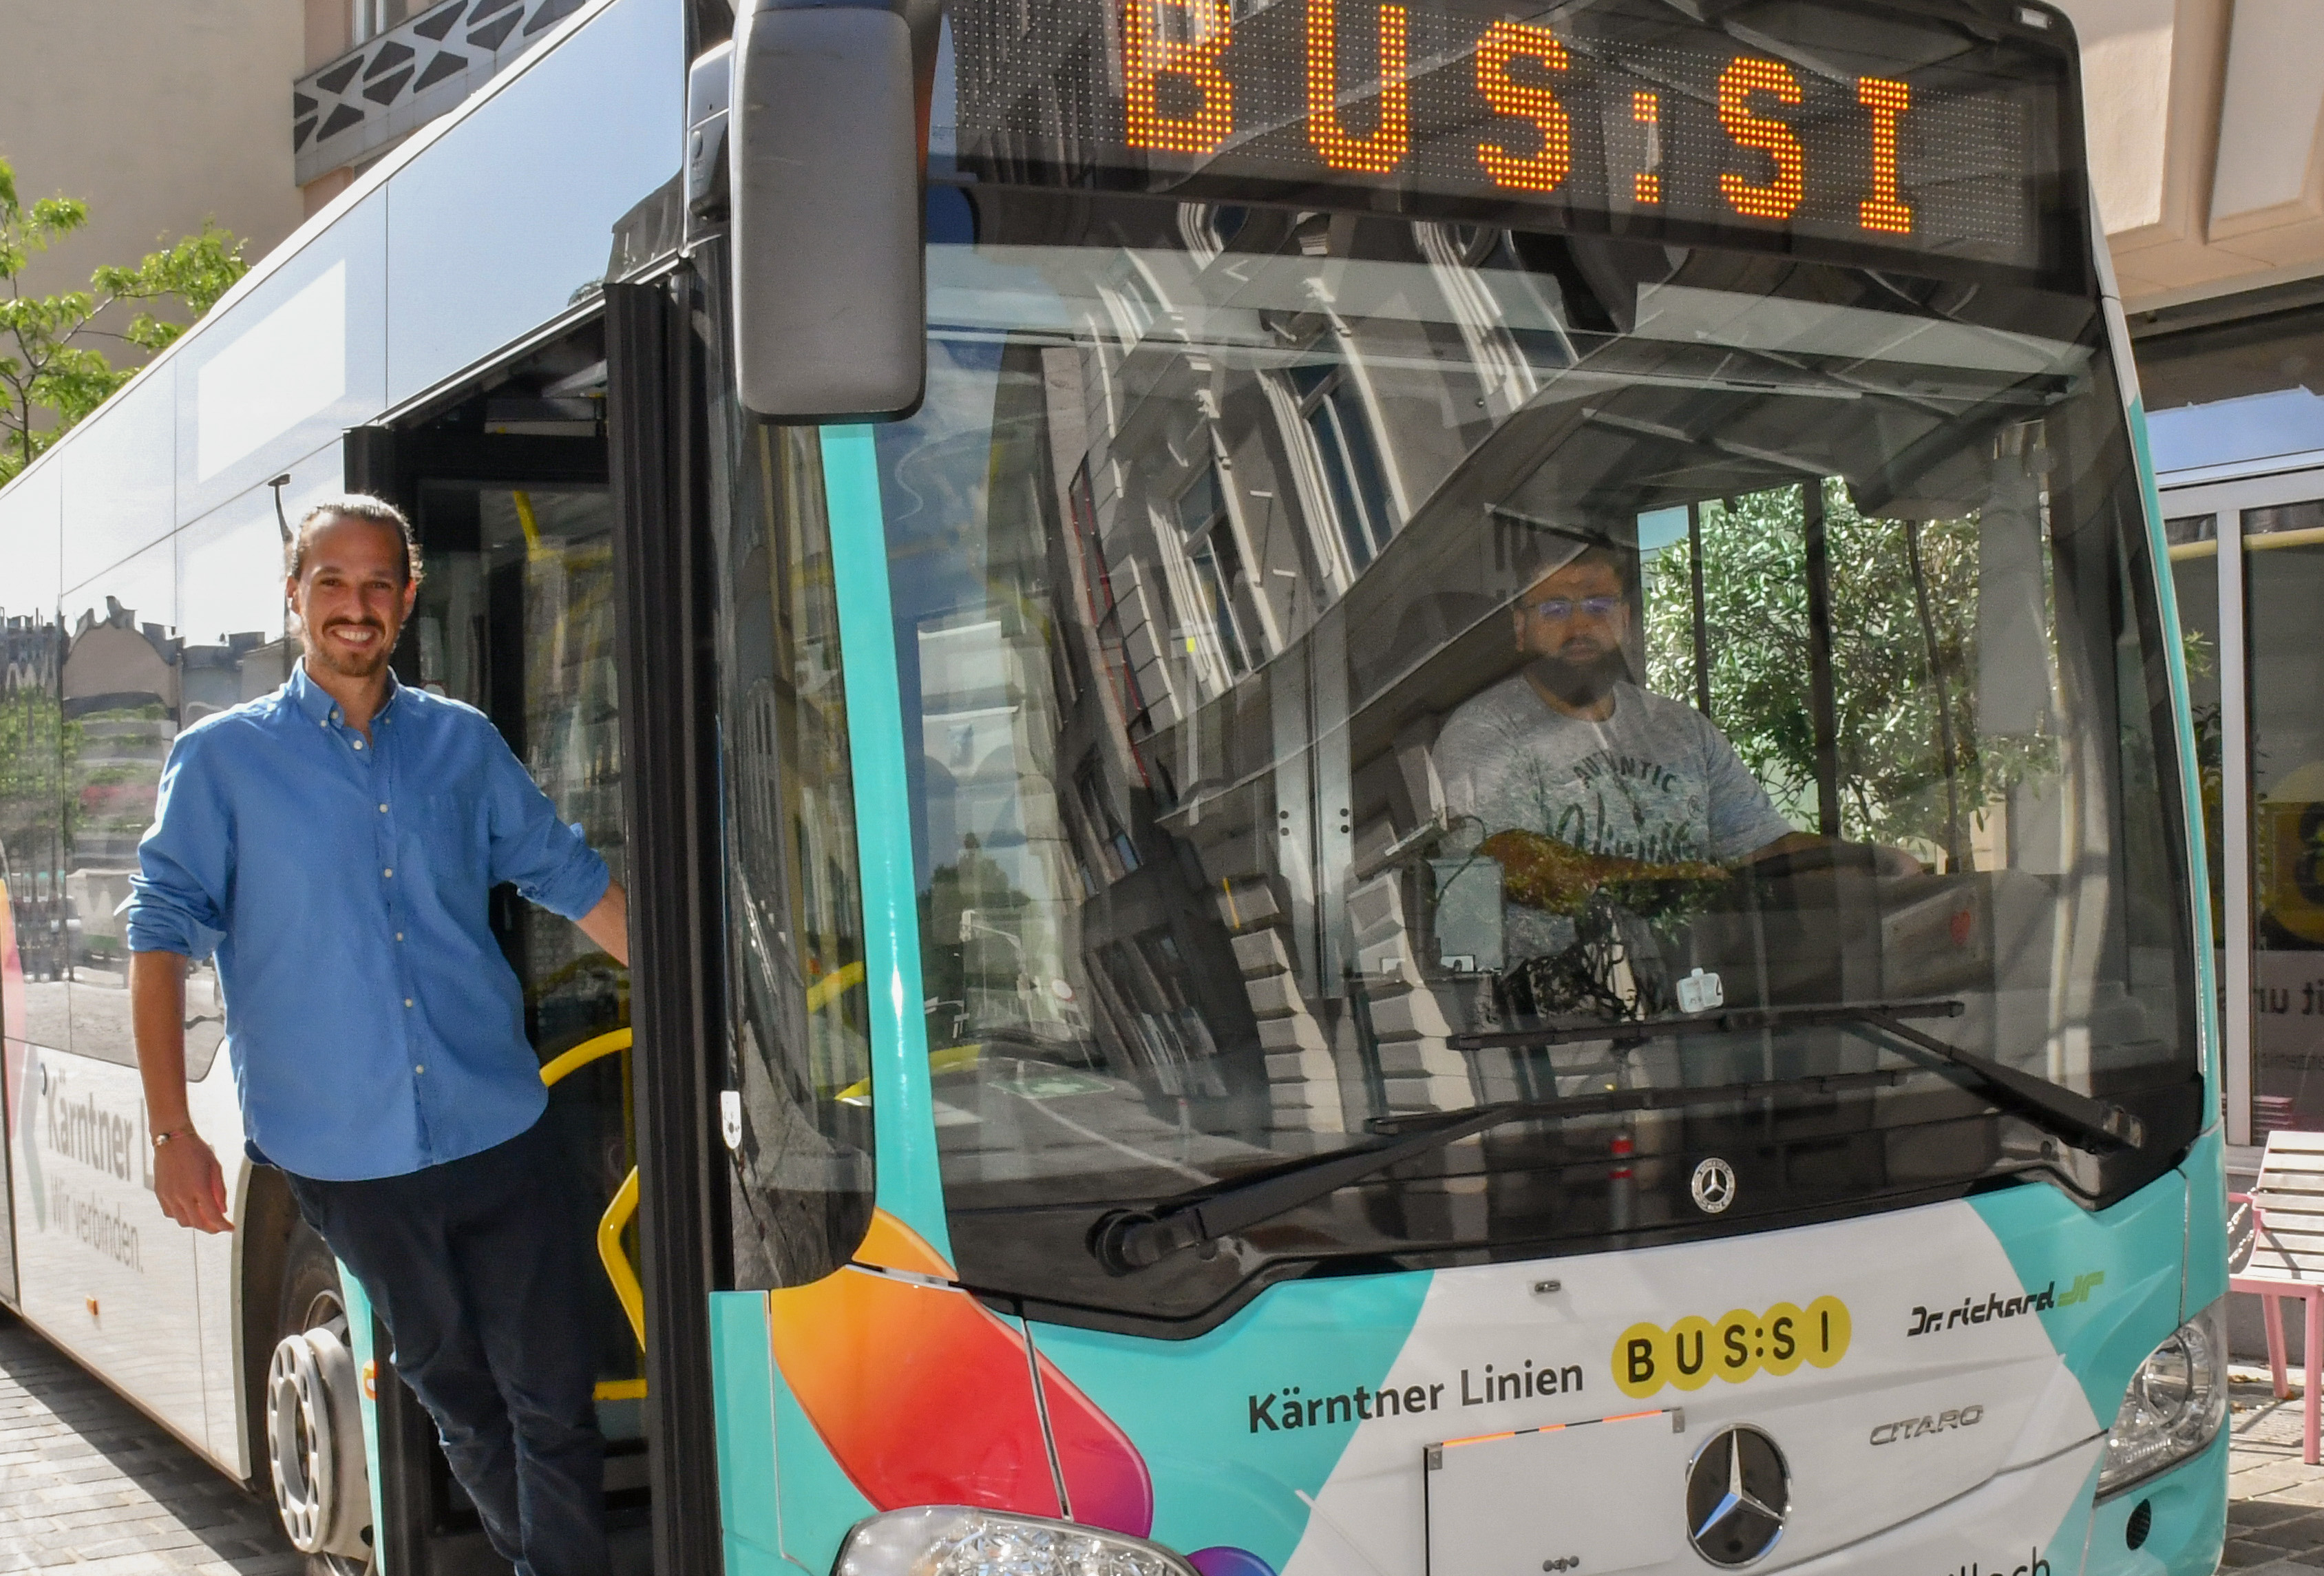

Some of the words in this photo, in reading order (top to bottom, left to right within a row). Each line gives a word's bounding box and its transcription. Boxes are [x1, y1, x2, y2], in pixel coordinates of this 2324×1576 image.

[47, 1068, 133, 1182] Kärntner
[50, 1173, 70, 1235] Wir
[72, 1189, 144, 1274] verbinden.
[1627, 1310, 1829, 1384] BUS:SI
[1248, 1383, 1446, 1434] Kärntner
[1460, 1358, 1584, 1407] Linien
[1870, 1404, 1984, 1445] CITARO
